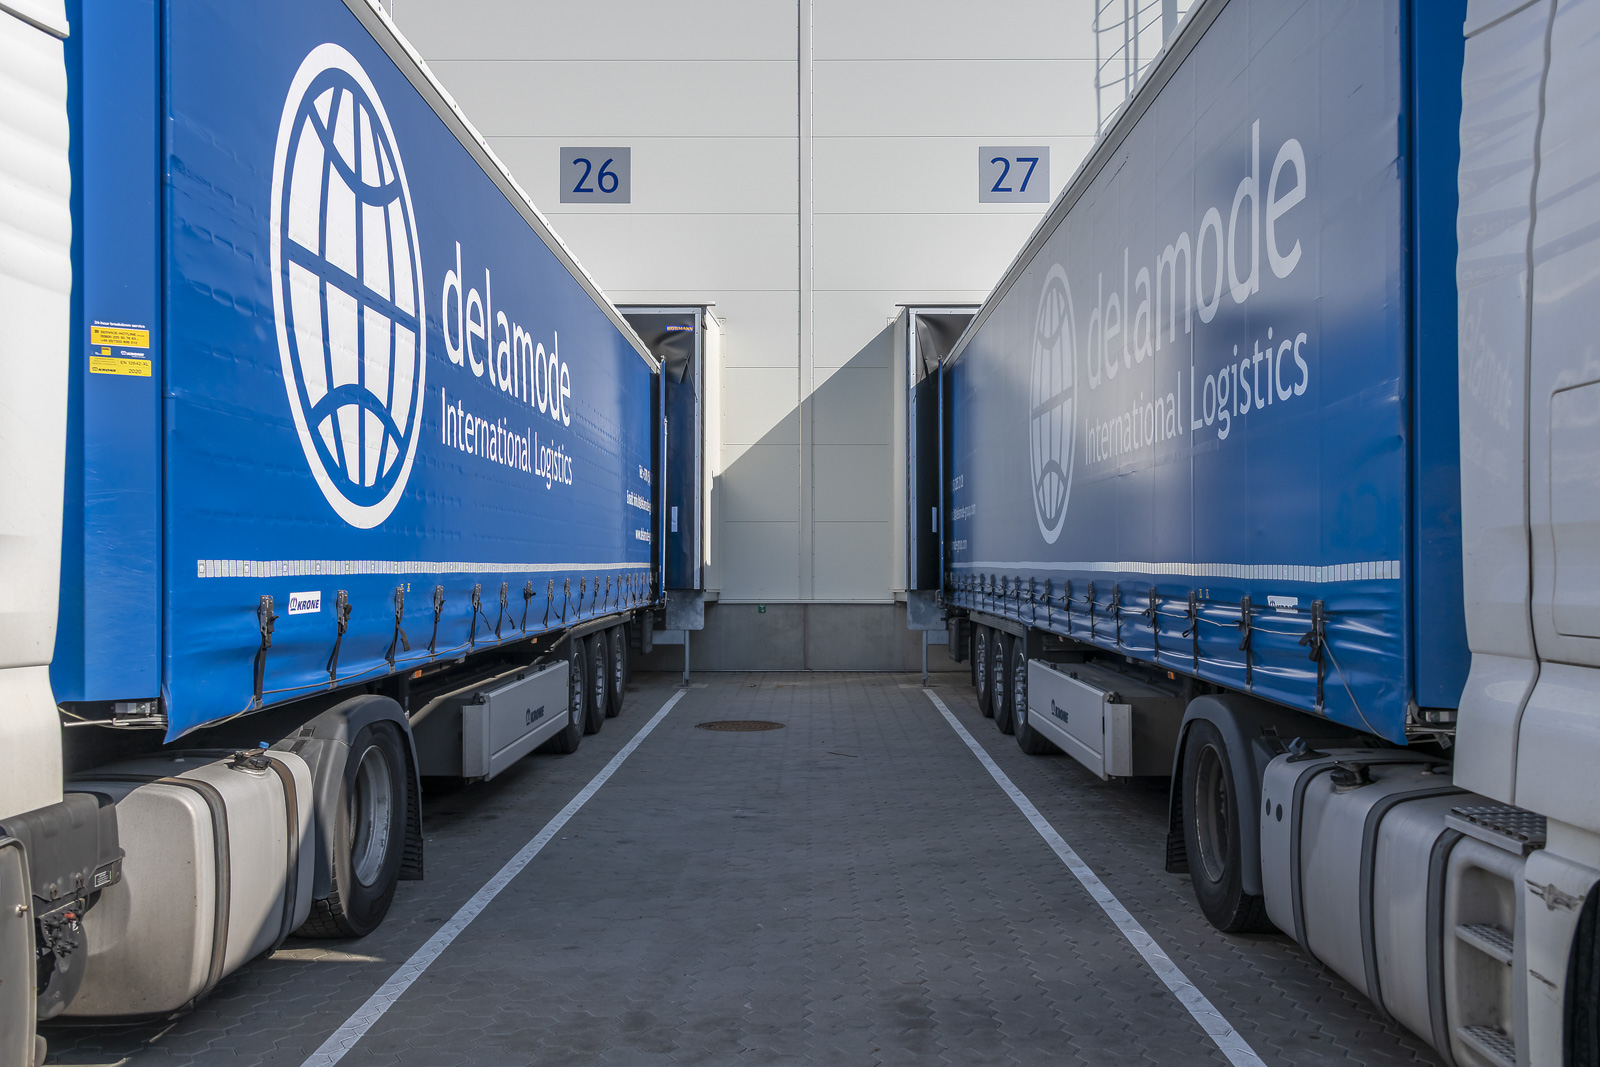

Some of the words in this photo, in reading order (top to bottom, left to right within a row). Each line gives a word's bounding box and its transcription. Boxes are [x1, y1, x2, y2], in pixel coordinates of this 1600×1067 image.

[573, 158, 619, 193] 26
[991, 157, 1038, 192] 27
[1087, 119, 1307, 390] delamode
[442, 240, 571, 427] delamode
[441, 386, 532, 474] International
[534, 425, 573, 489] Logistics
[1085, 371, 1184, 466] International
[1190, 327, 1309, 441] Logistics
[297, 599, 320, 611] KRONE
